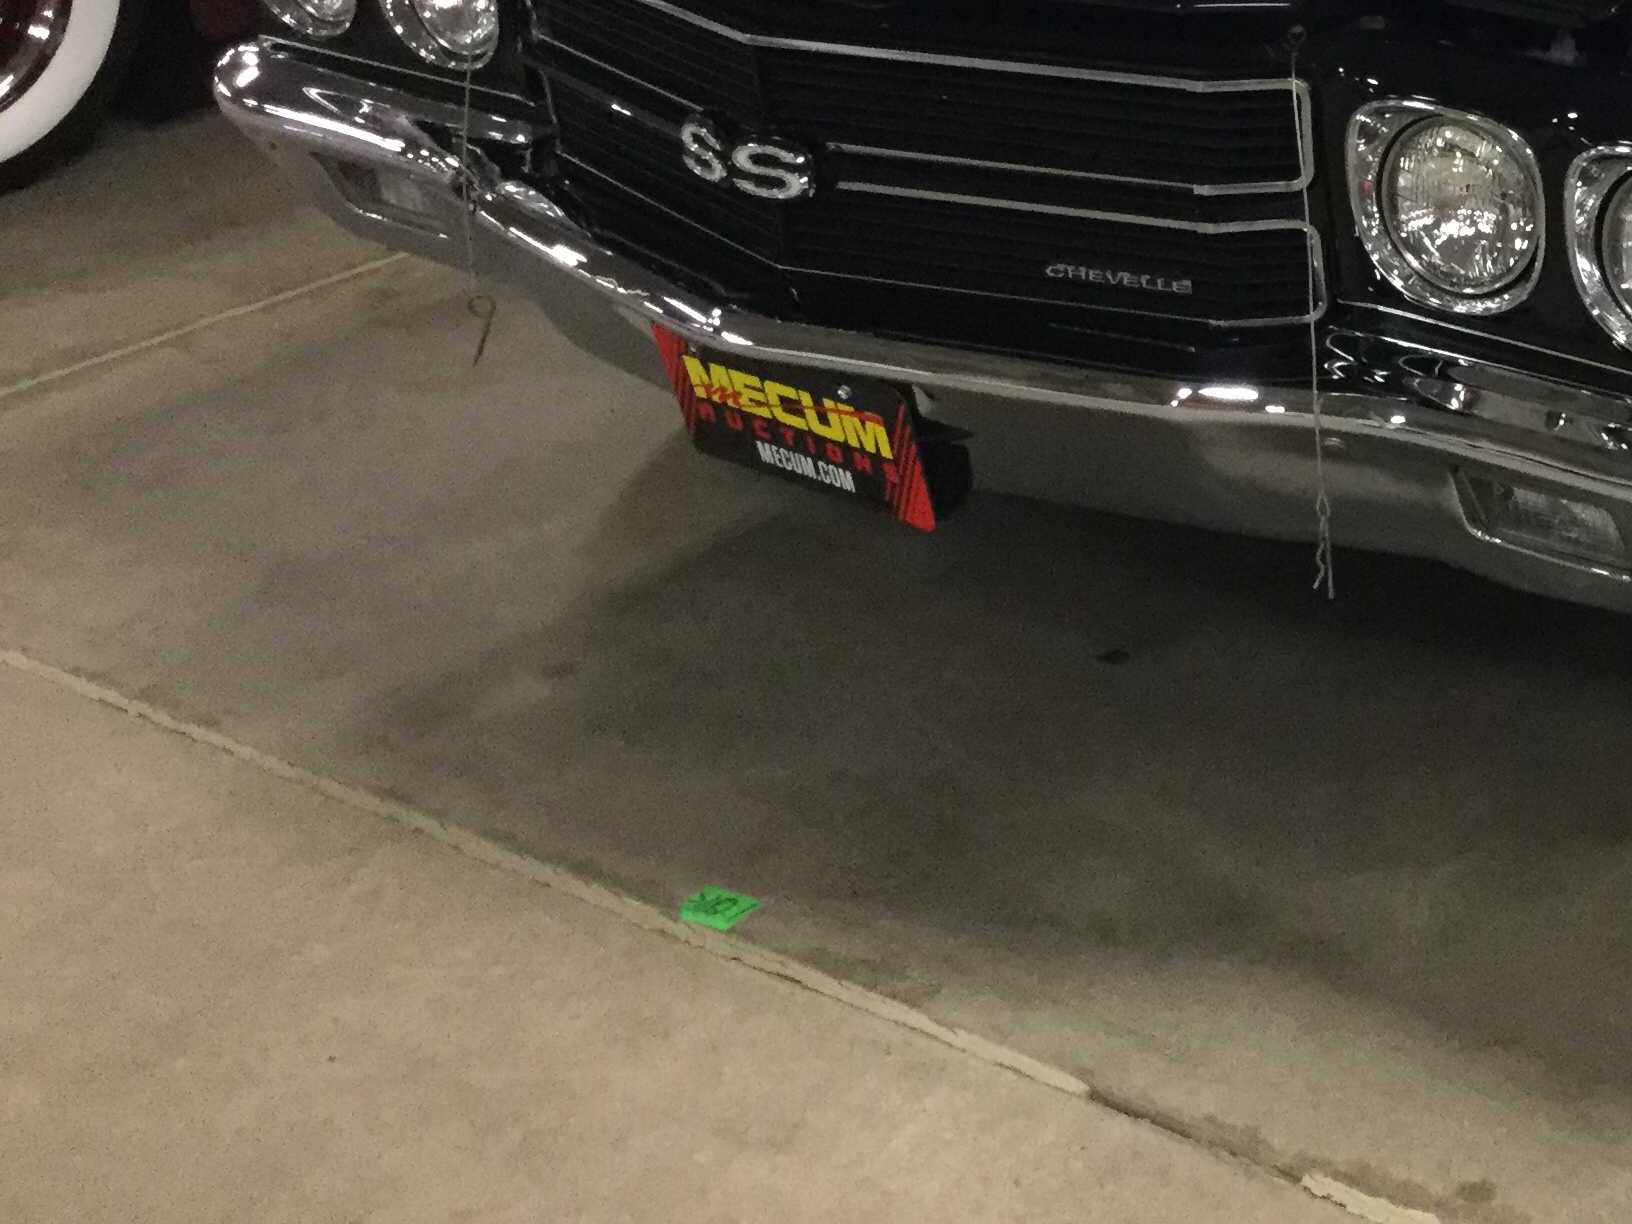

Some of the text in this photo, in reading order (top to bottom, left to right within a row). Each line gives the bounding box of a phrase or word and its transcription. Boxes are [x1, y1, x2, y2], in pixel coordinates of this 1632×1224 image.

[681, 121, 812, 200] SS
[1045, 263, 1193, 294] CHEVELLE
[682, 354, 893, 460] MECUM
[697, 401, 900, 484] AUCTIONS
[756, 440, 856, 493] MECUM.COM
